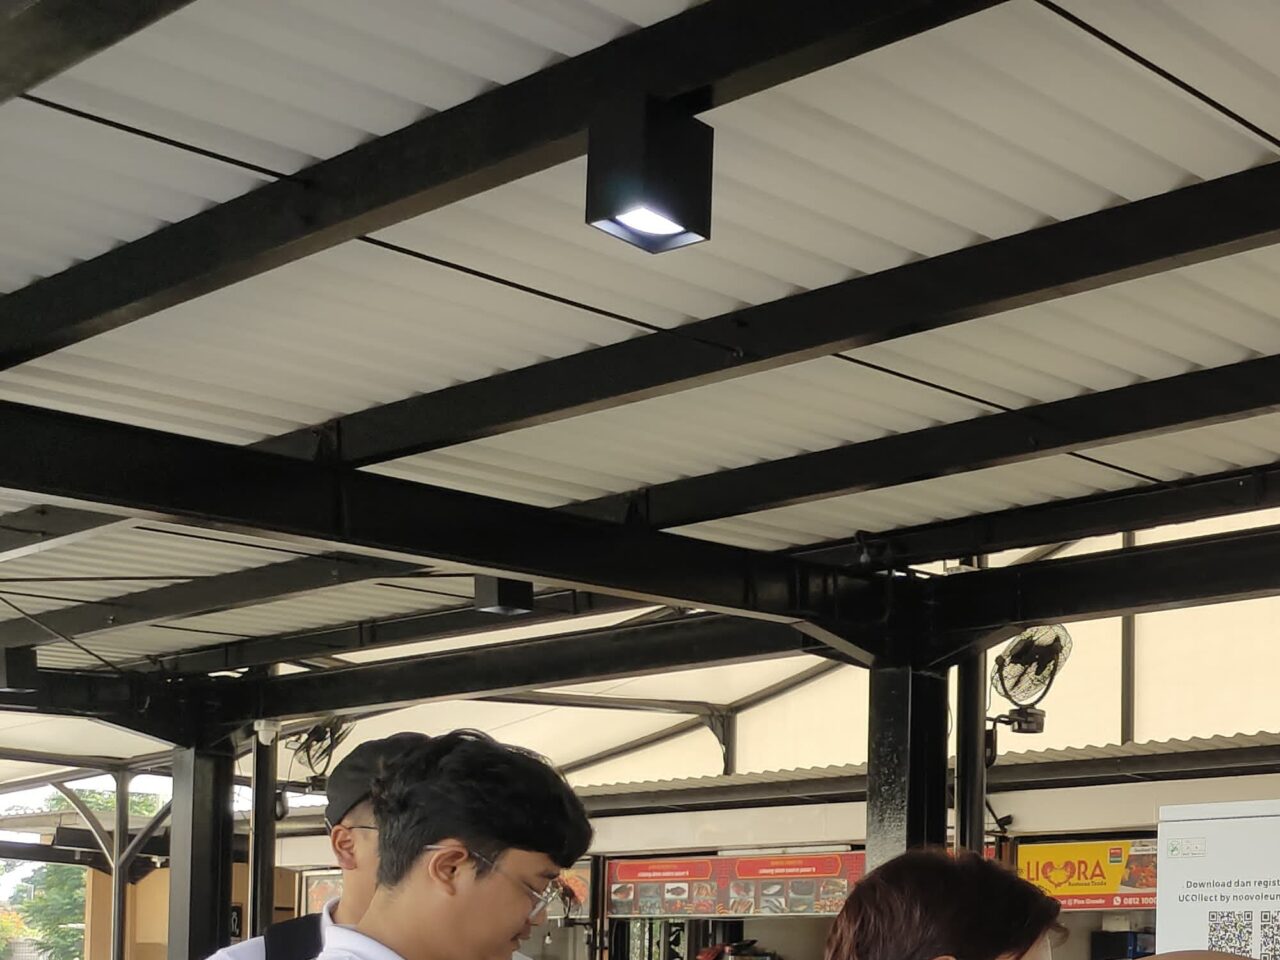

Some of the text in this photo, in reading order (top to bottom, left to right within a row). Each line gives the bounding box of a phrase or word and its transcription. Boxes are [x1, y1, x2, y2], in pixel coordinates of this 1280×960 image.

[1186, 880, 1232, 889] Download
[1234, 879, 1251, 888] dan
[1220, 893, 1231, 903] by
